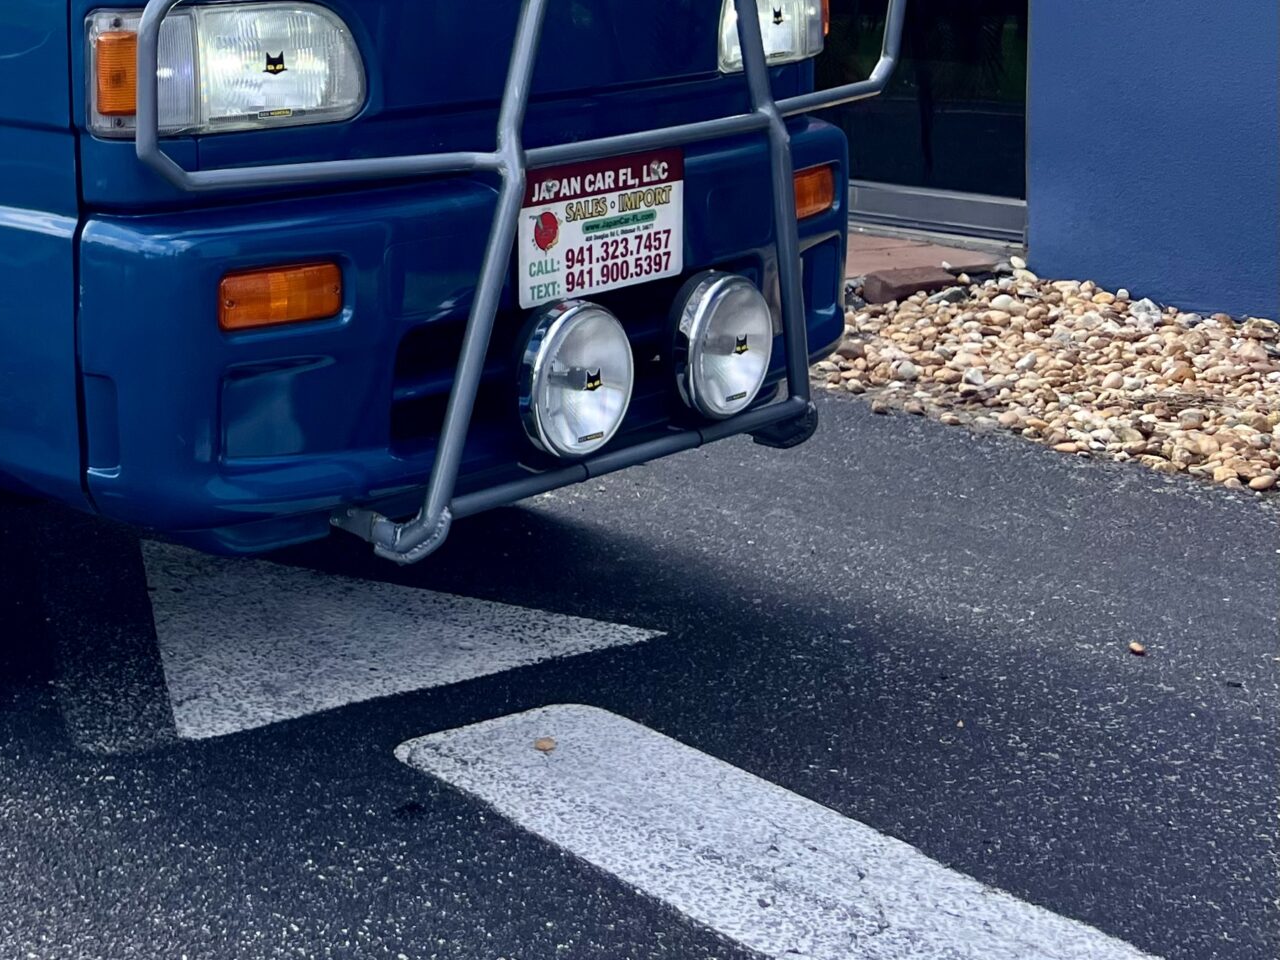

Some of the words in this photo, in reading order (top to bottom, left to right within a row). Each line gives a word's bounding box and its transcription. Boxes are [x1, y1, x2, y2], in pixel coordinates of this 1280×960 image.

[531, 176, 581, 203] JAPAN
[584, 170, 615, 193] CAR
[619, 167, 639, 188] FL,
[565, 196, 608, 222] SALES
[618, 186, 672, 213] IMPORT
[529, 257, 561, 278] CALL:
[565, 228, 672, 270] 941.323.7457
[529, 281, 561, 301] TEXT:
[565, 251, 672, 292] 941.900.5397
